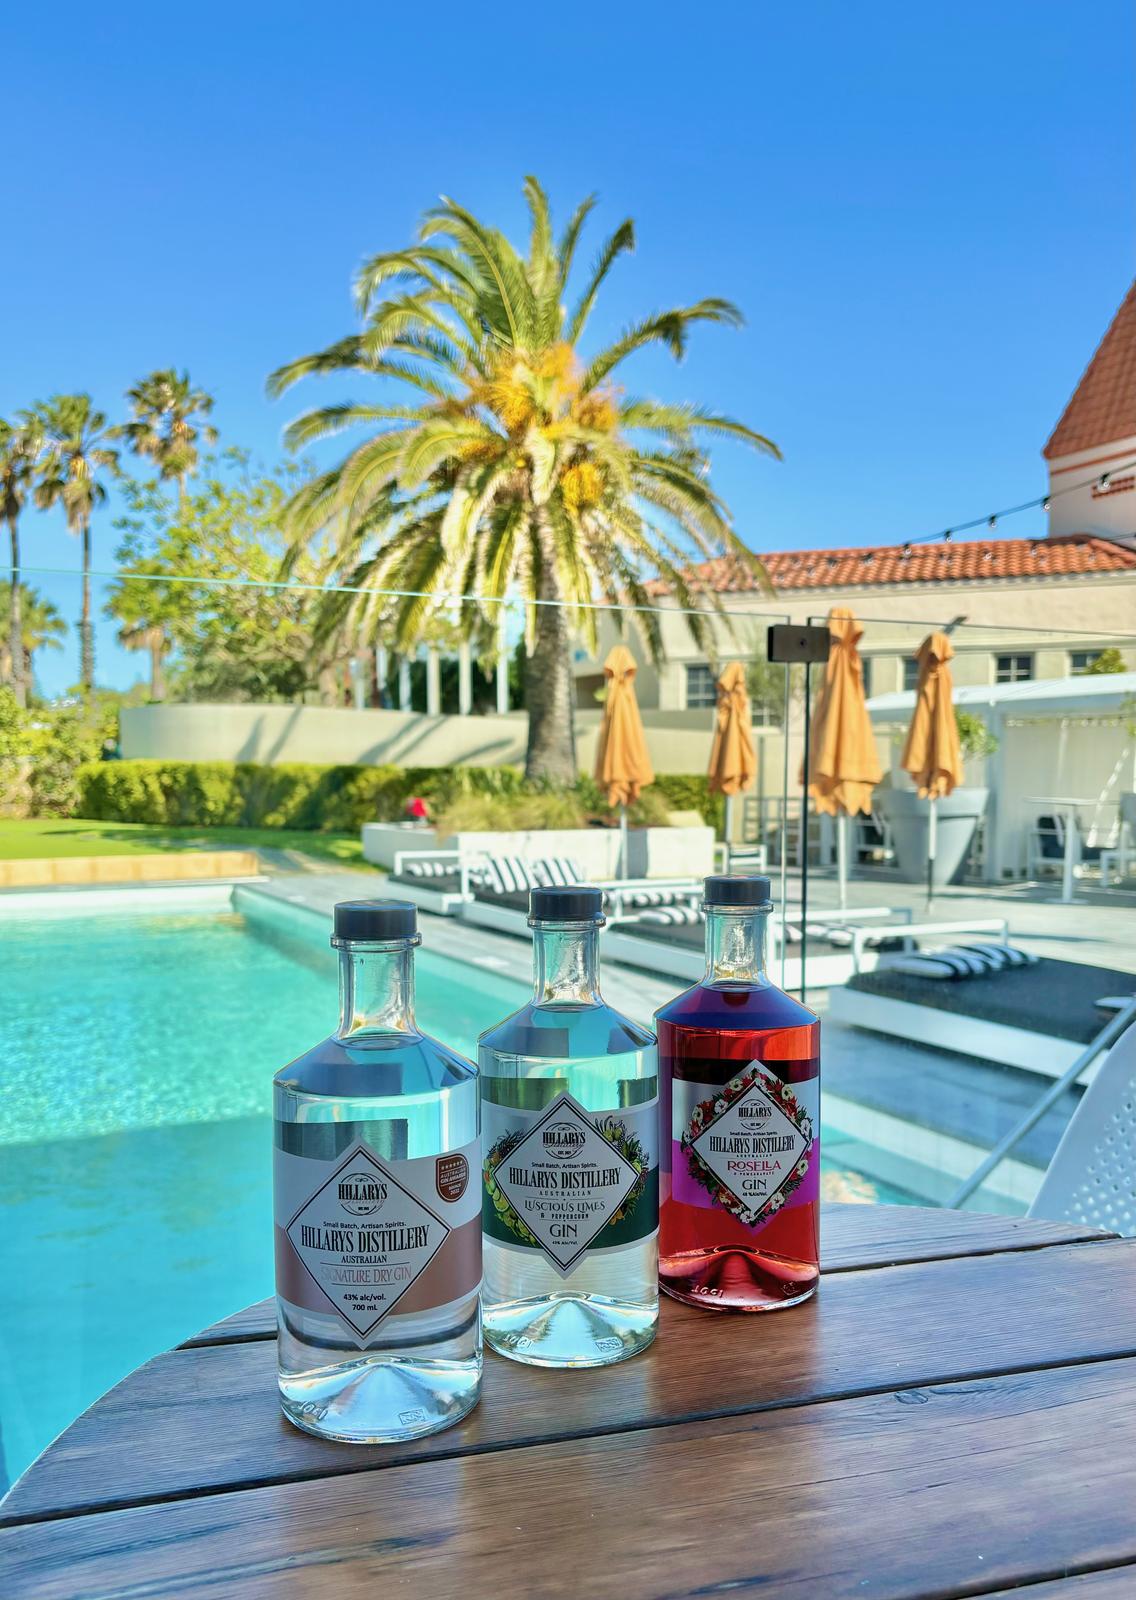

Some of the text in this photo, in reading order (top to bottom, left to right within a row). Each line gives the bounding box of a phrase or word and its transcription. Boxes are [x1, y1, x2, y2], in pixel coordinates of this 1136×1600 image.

[739, 1107, 772, 1118] HILLARYS
[543, 1132, 586, 1145] HILLARYS
[709, 1135, 796, 1154] HILLARYS DISTILLERY
[727, 1160, 782, 1173] ROSELLA
[509, 1167, 621, 1189] HILLARYS DISTILLERY
[742, 1179, 767, 1190] GIN
[338, 1183, 388, 1200] HILLARYS
[524, 1200, 606, 1213] LUSCIOUS LIMES
[340, 1222, 360, 1230] Batch,
[361, 1222, 383, 1230] Artisan
[385, 1221, 407, 1229] Spirits.
[549, 1224, 577, 1238] GIN
[301, 1224, 430, 1253] HILLARYS DISTILLERY
[341, 1255, 388, 1264] AUSTRALIAN
[321, 1266, 412, 1283] SIGNATURE DRY GIN
[343, 1293, 387, 1301] 43% alc/vol.
